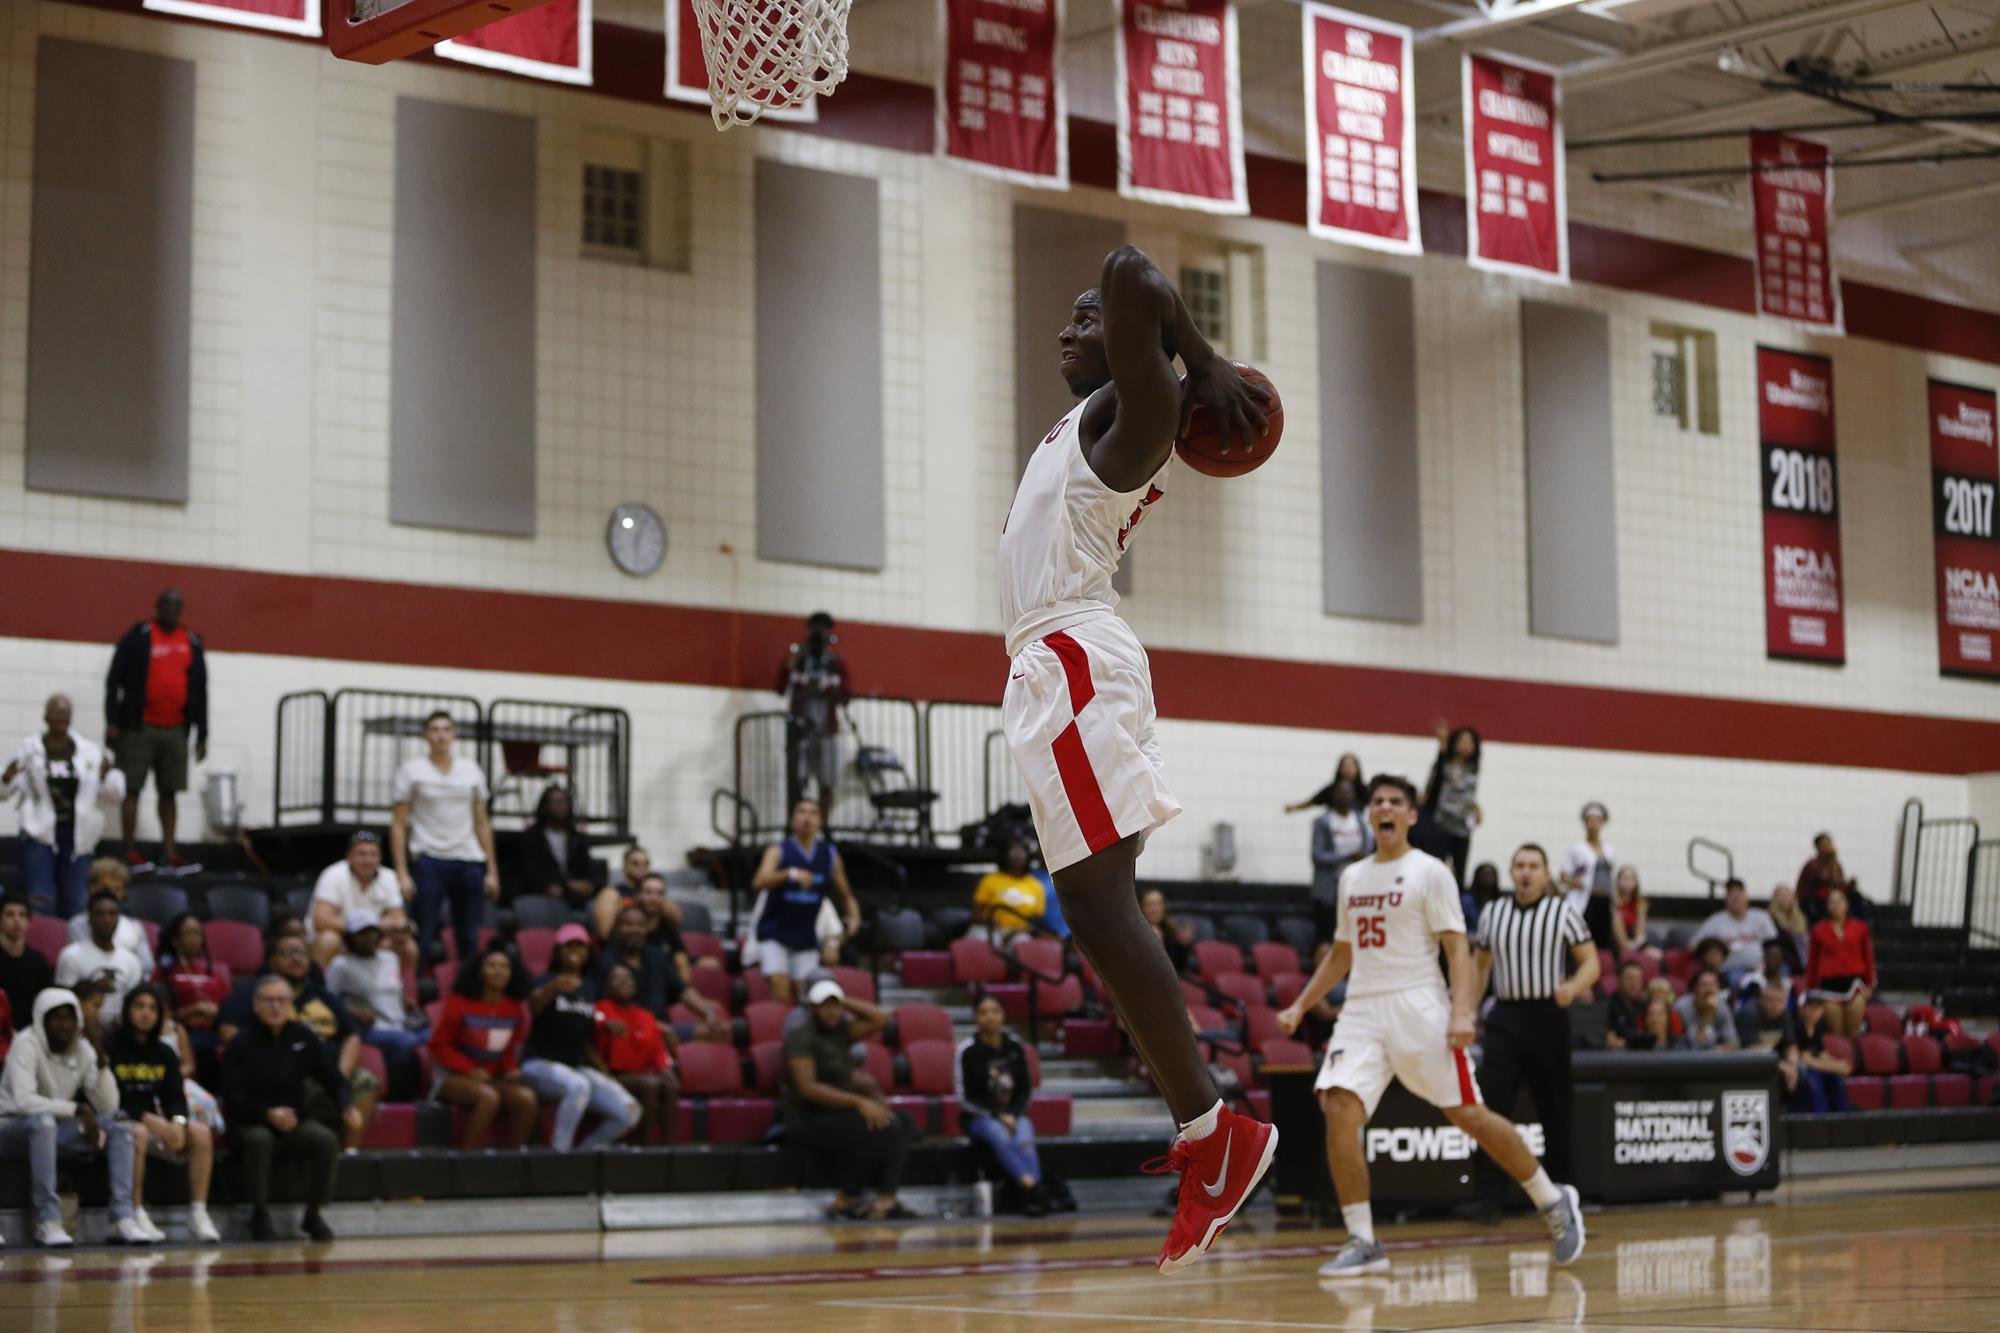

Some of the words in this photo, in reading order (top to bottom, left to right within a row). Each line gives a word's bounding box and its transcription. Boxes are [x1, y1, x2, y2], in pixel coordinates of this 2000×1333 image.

[1770, 448, 1833, 514] 2018
[1944, 476, 1994, 537] 2017
[1773, 545, 1837, 579] NCAA
[1945, 567, 1999, 601] NCAA
[1357, 915, 1387, 949] 25
[1615, 1117, 1715, 1142] NATIONAL
[1615, 1140, 1716, 1164] CHAMPIONS
